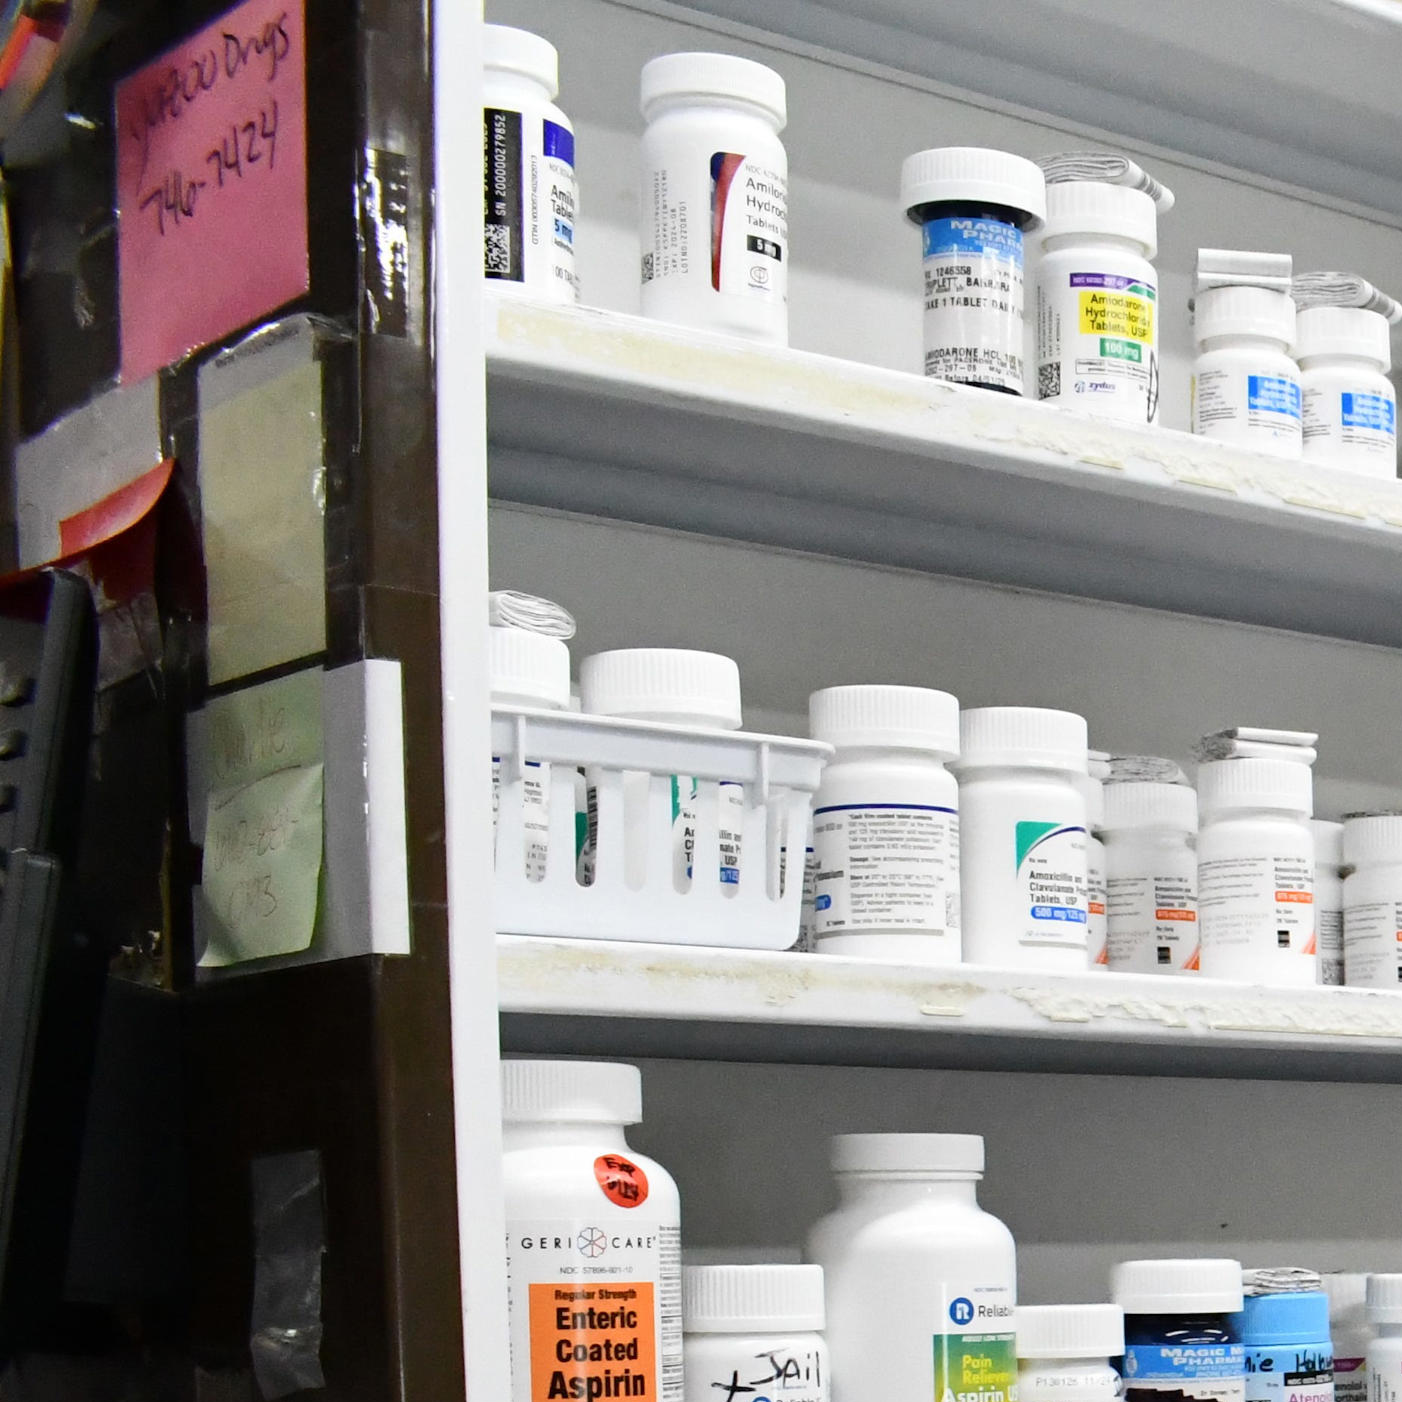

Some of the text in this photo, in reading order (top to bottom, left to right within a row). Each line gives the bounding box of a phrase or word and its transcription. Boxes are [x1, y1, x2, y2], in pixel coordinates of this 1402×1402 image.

[139, 97, 278, 235] 746-7424
[521, 1237, 571, 1250] GERI
[555, 1289, 637, 1301] Regular Strength
[556, 1306, 637, 1330] Enteric
[556, 1338, 638, 1362] Coated
[1161, 1348, 1225, 1357] MAGIC
[963, 1355, 992, 1368] Pain
